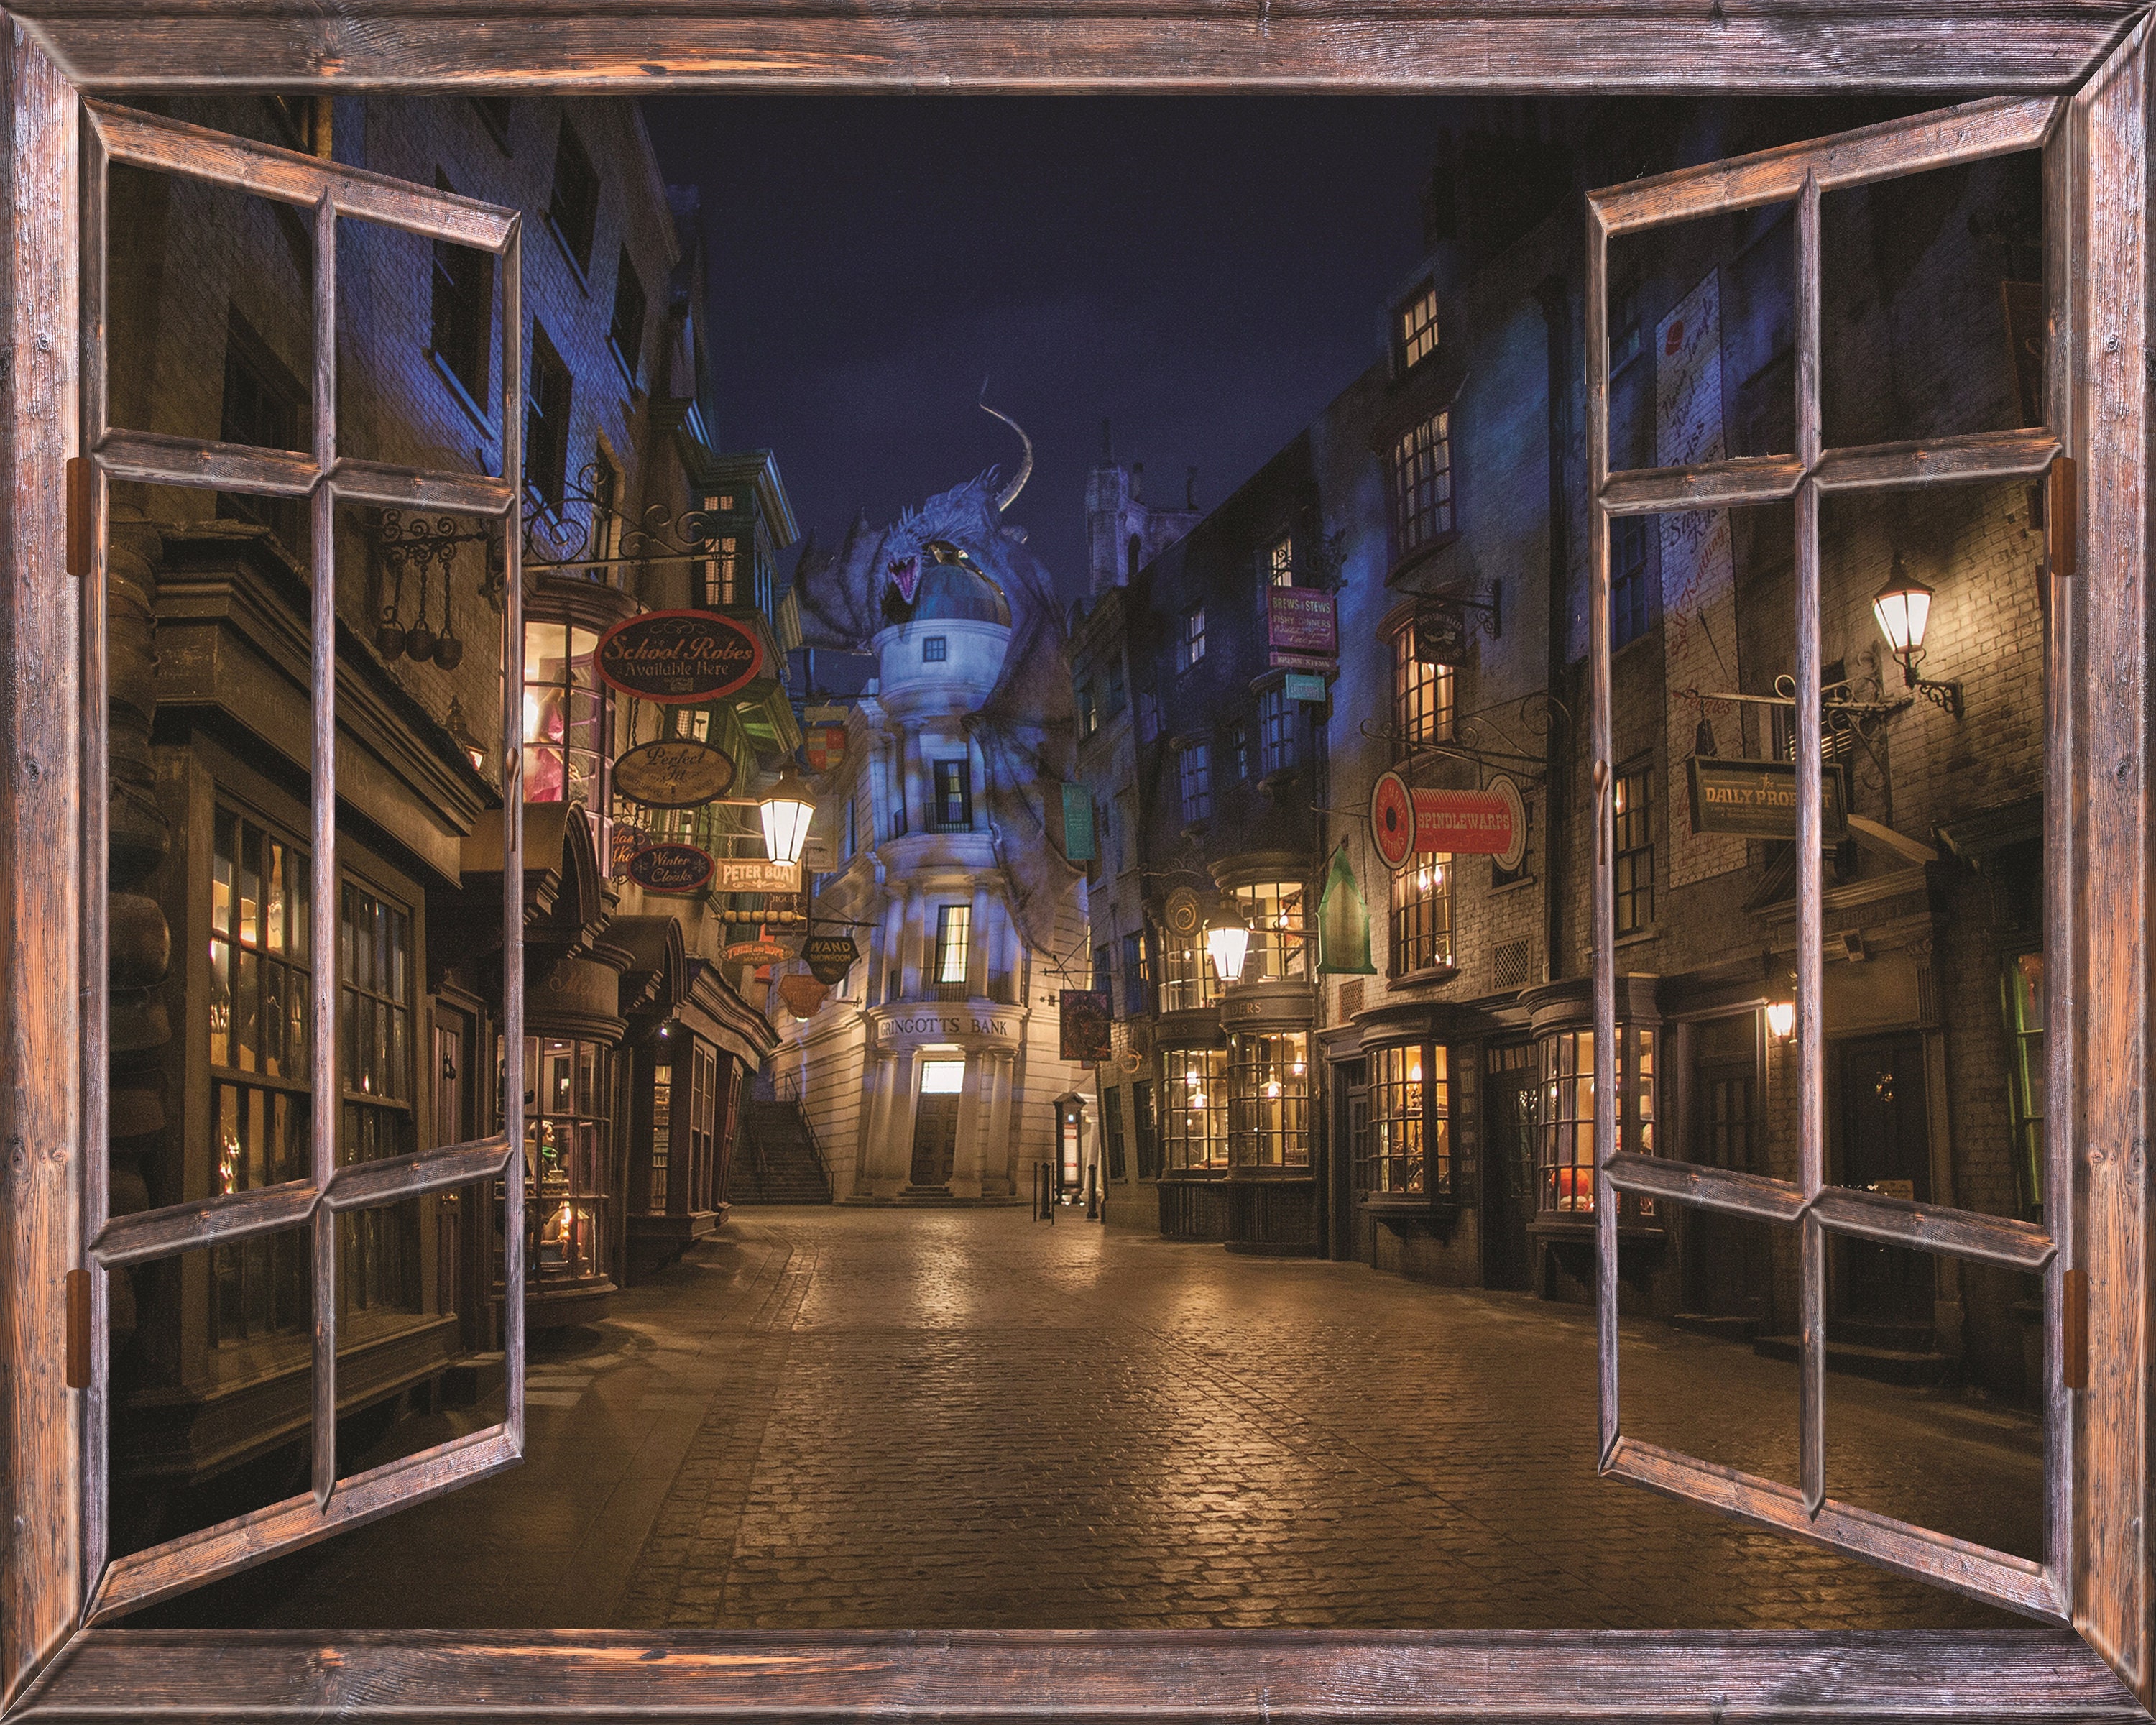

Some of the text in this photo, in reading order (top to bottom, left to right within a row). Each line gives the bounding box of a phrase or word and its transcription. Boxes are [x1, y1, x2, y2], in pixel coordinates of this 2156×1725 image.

[1272, 597, 1299, 611] BREWS
[1305, 600, 1331, 614] STEWS
[604, 635, 753, 661] School Robes
[624, 661, 729, 677] Available Here
[645, 745, 706, 766] Perfect
[662, 764, 687, 781] Fit
[1705, 787, 1751, 804] DAILY
[1754, 790, 1831, 809] PROPT
[1417, 811, 1509, 831] SPINDLEWARPS
[651, 851, 691, 867] Winter
[650, 867, 694, 883] Cloaks
[722, 864, 797, 885] PETER BOAT
[810, 941, 852, 952] WAND
[809, 954, 852, 962] SHOWROOM
[880, 1017, 1008, 1036] GRINGOTTS BANK
